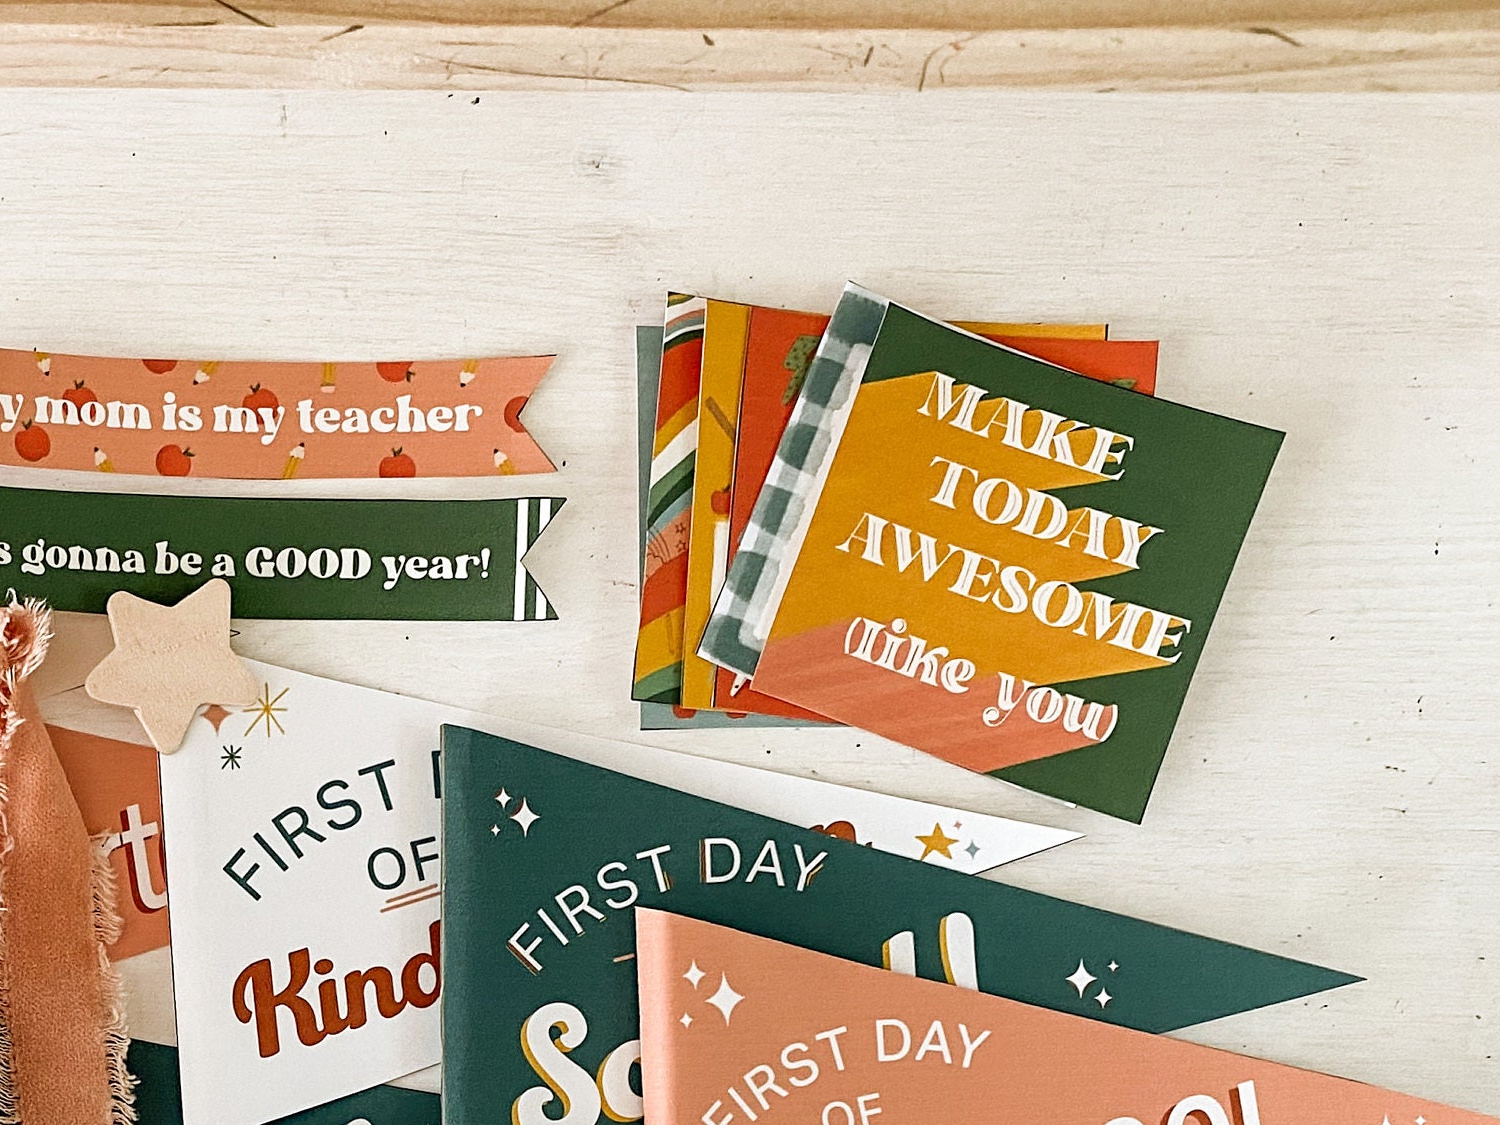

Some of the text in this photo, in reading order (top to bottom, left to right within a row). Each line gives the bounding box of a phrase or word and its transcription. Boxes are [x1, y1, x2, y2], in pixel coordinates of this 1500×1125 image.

[34, 396, 152, 431] mom
[162, 391, 203, 432] is
[213, 403, 285, 446] my
[297, 395, 484, 435] teacher
[917, 370, 1136, 481] MAKE
[929, 455, 1166, 571] TODAY
[21, 538, 146, 576] gonna
[155, 539, 202, 578] be
[211, 554, 236, 579] a
[245, 546, 372, 580] GOOD
[381, 548, 491, 589] year!
[835, 510, 1193, 665] AWESOME
[983, 669, 1119, 743] you)
[222, 758, 397, 901] FIRST
[367, 836, 441, 890] OF
[507, 837, 828, 975] FIRST DAY
[876, 1018, 992, 1069] DAY
